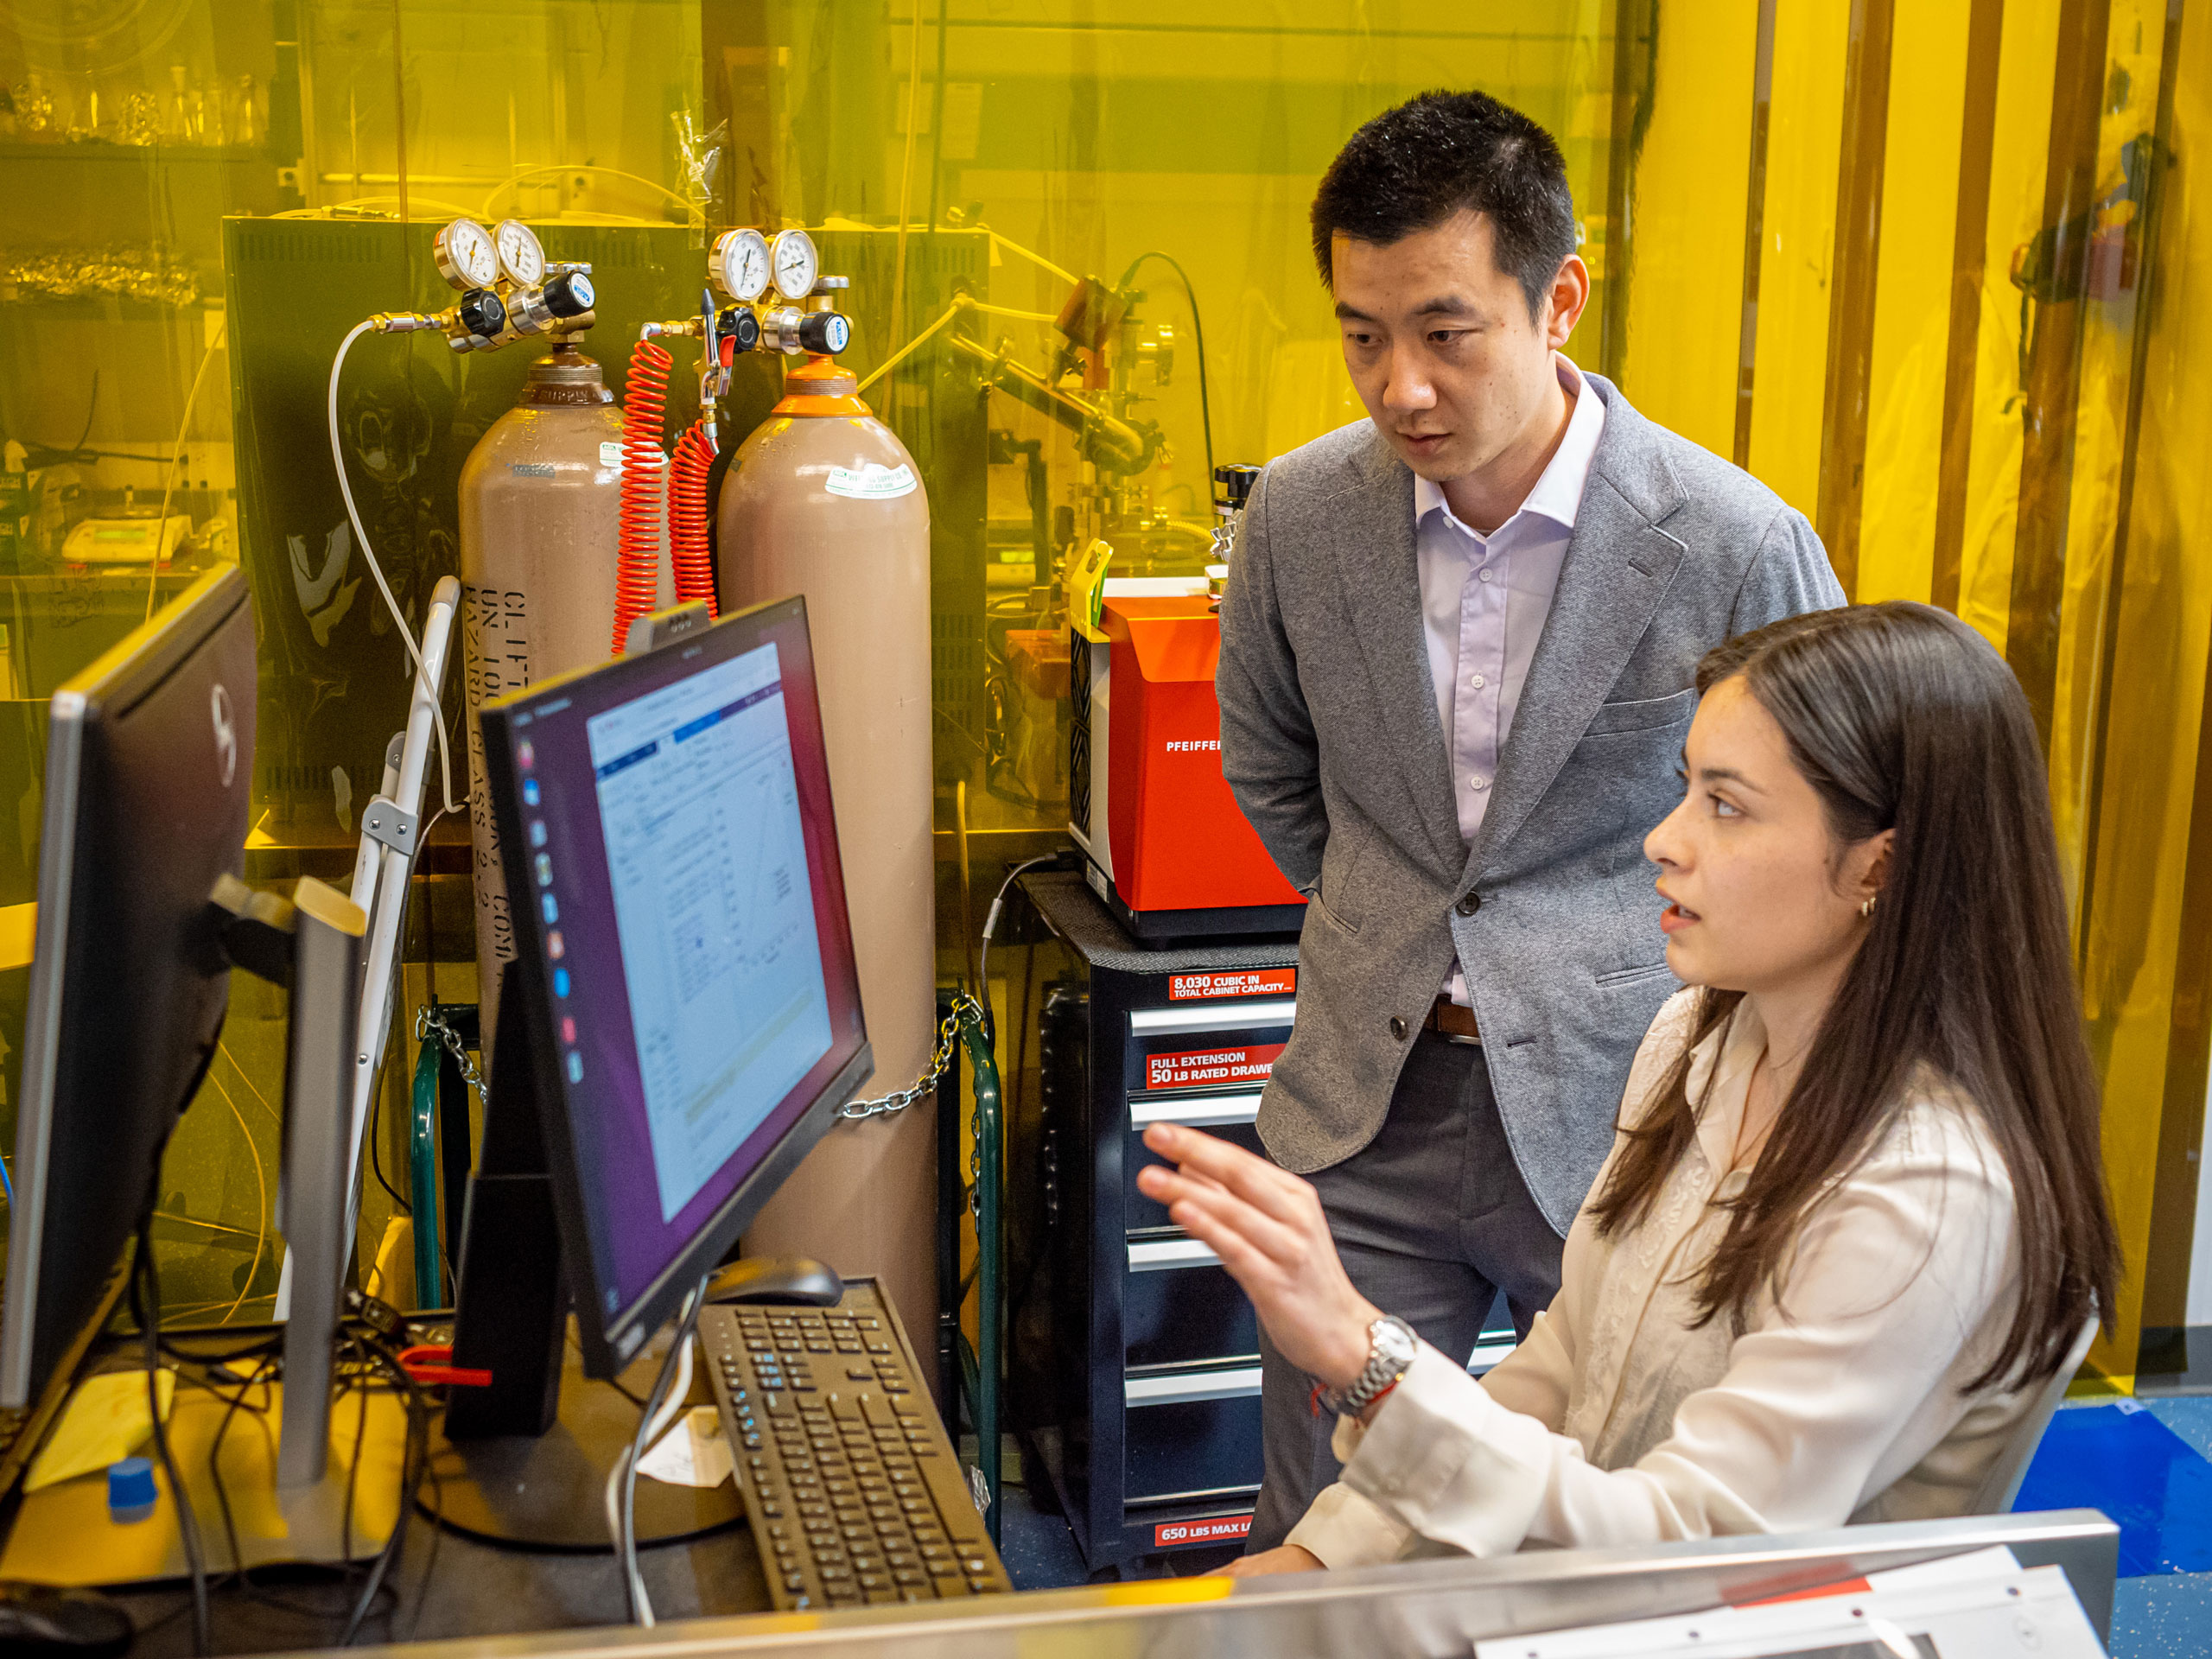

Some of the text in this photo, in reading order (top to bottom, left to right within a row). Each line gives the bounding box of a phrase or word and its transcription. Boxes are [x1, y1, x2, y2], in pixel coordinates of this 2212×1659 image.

[481, 589, 499, 628] UN
[467, 587, 481, 707] HAZARD
[472, 730, 486, 828] CLASS
[1174, 975, 1260, 990] 8,030 CUBIC IN
[1174, 988, 1201, 998] TOTAL
[1203, 986, 1240, 996] CABINET
[1151, 1052, 1245, 1069] FULL EXTENSION
[1152, 1070, 1172, 1083] 50
[1174, 1071, 1188, 1081] LB
[1191, 1068, 1228, 1078] RATED
[1161, 1527, 1187, 1540] 650
[1190, 1527, 1210, 1536] LBS
[1211, 1524, 1238, 1535] MAX
